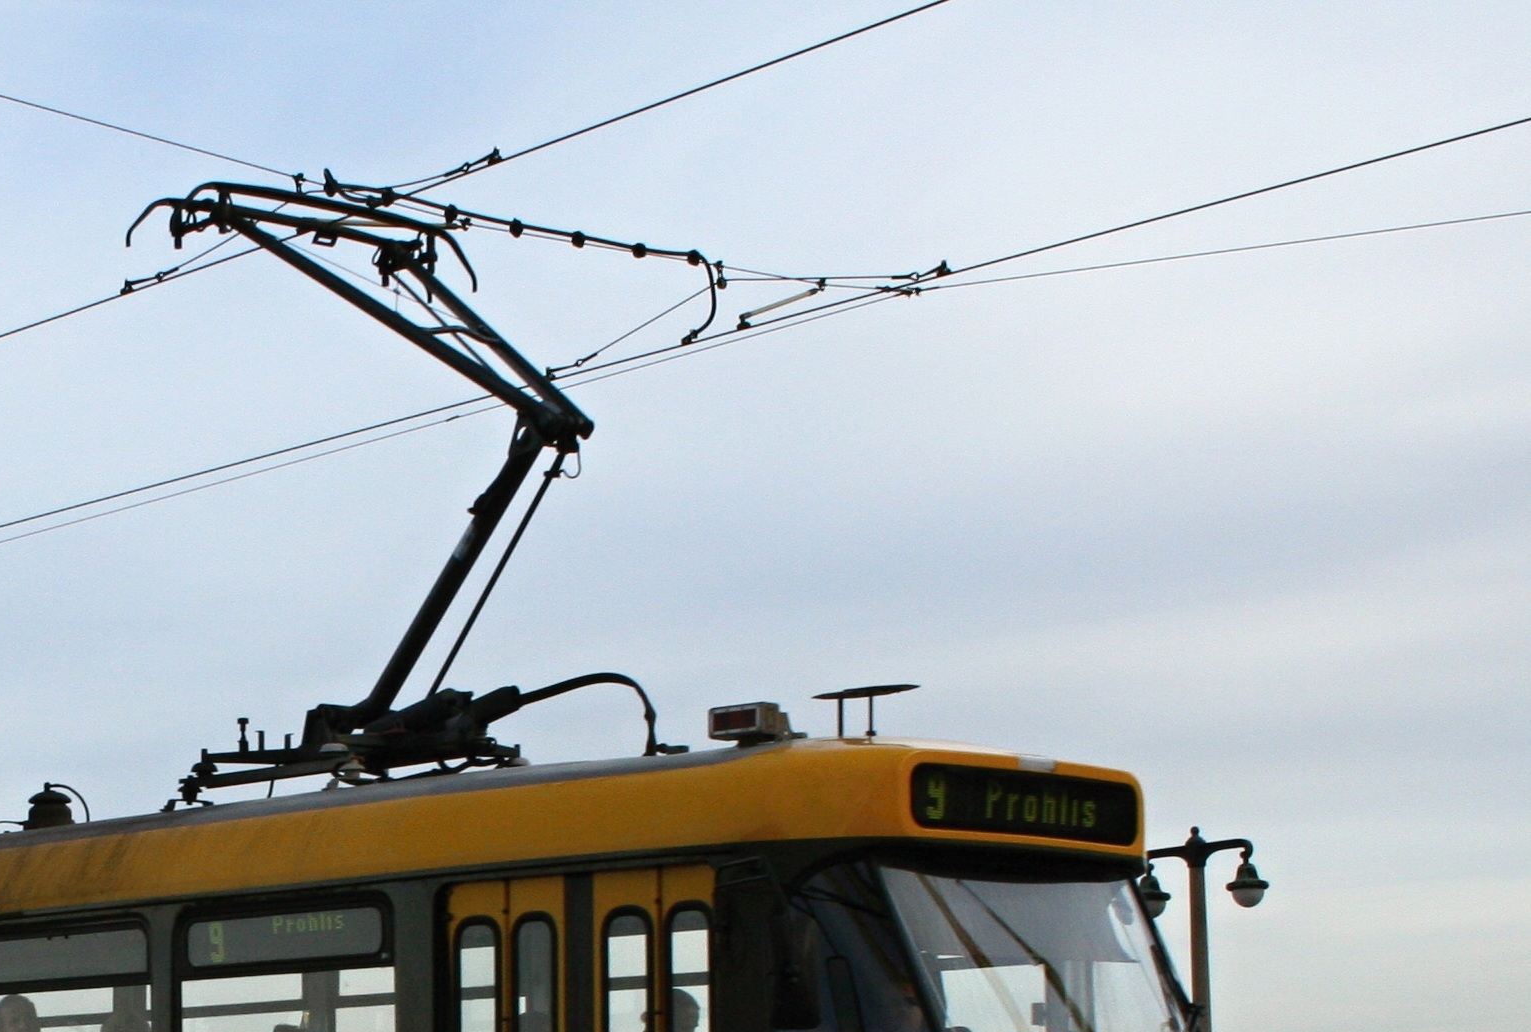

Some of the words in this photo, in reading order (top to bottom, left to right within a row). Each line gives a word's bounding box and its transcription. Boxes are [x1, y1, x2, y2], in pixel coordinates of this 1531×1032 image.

[925, 774, 946, 821] 9
[984, 783, 1098, 828] Prohlis
[208, 920, 226, 965] 9
[272, 912, 345, 935] Prohlis
